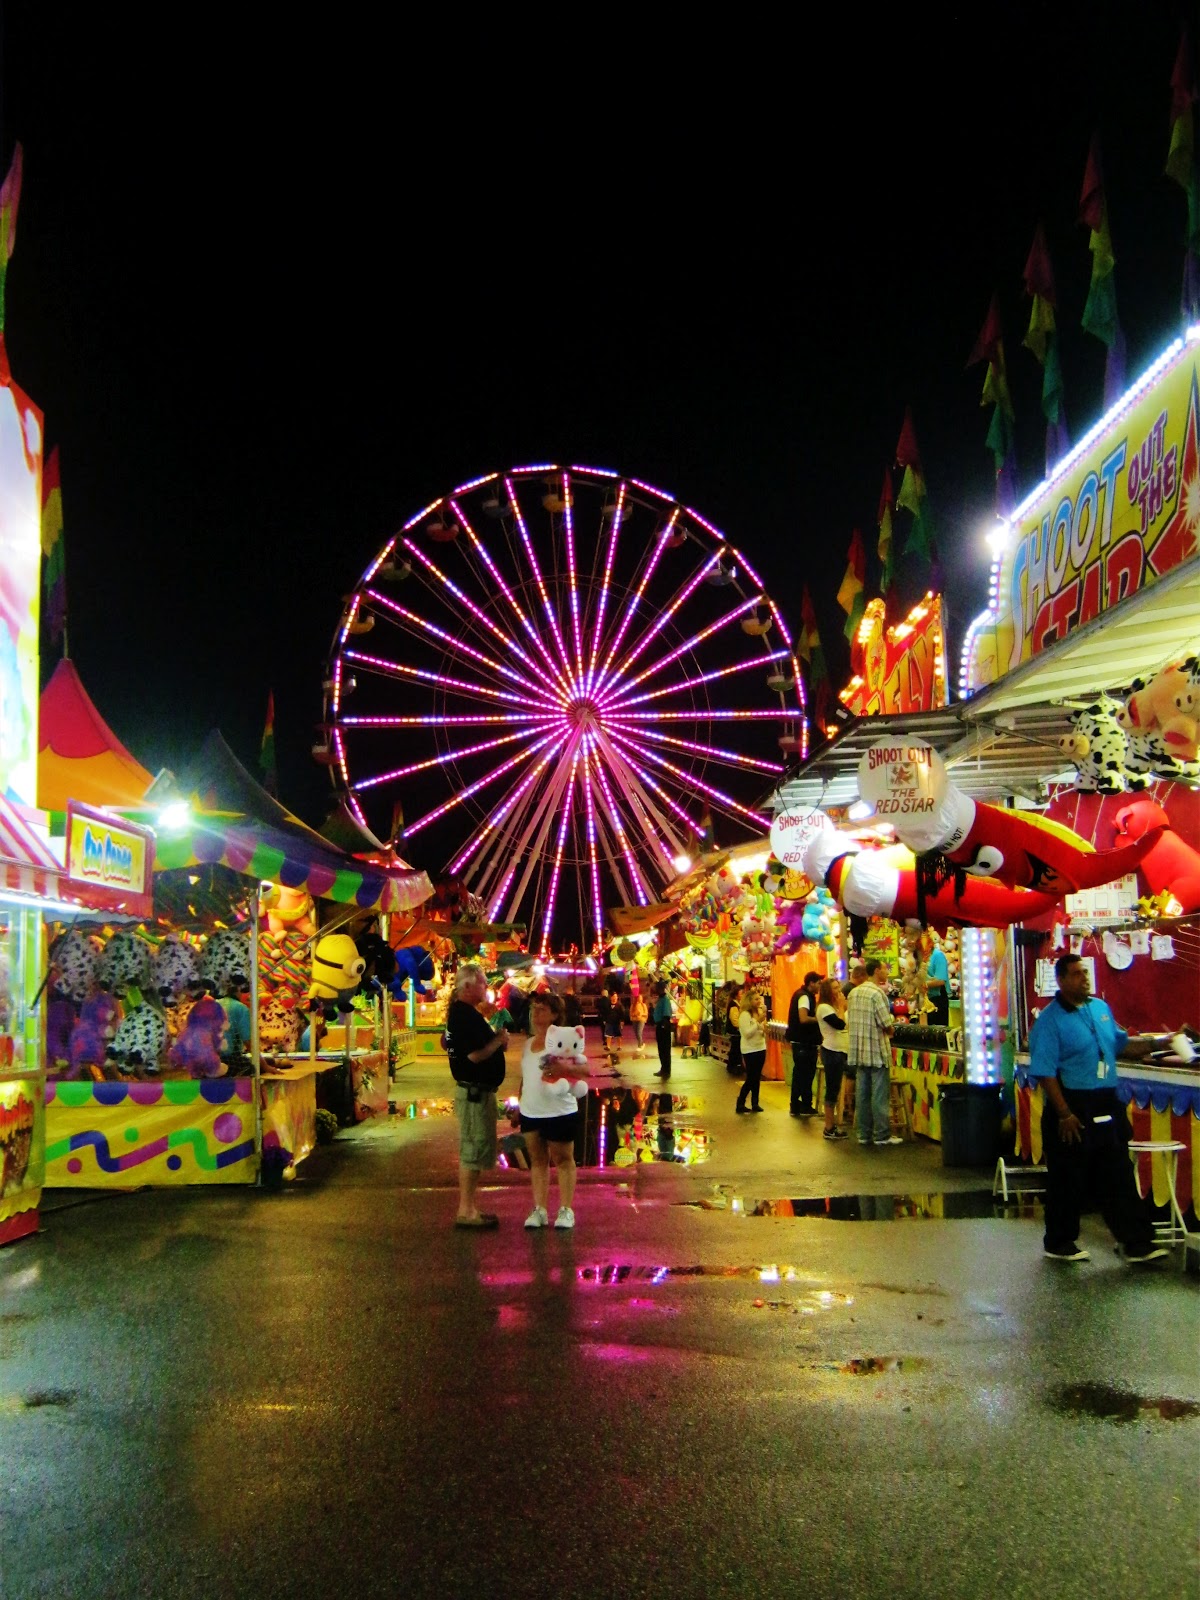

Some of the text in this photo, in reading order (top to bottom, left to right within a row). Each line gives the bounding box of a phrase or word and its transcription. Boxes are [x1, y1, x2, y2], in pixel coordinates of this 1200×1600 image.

[1127, 408, 1168, 506] OUT
[1138, 443, 1178, 537] THE
[1008, 436, 1128, 672] SHOOT
[868, 746, 933, 770] SHOOT OUT
[891, 788, 916, 798] THE
[874, 797, 935, 814] RED STAR
[778, 814, 825, 832] SHOOT OUT
[782, 851, 801, 863] RED
